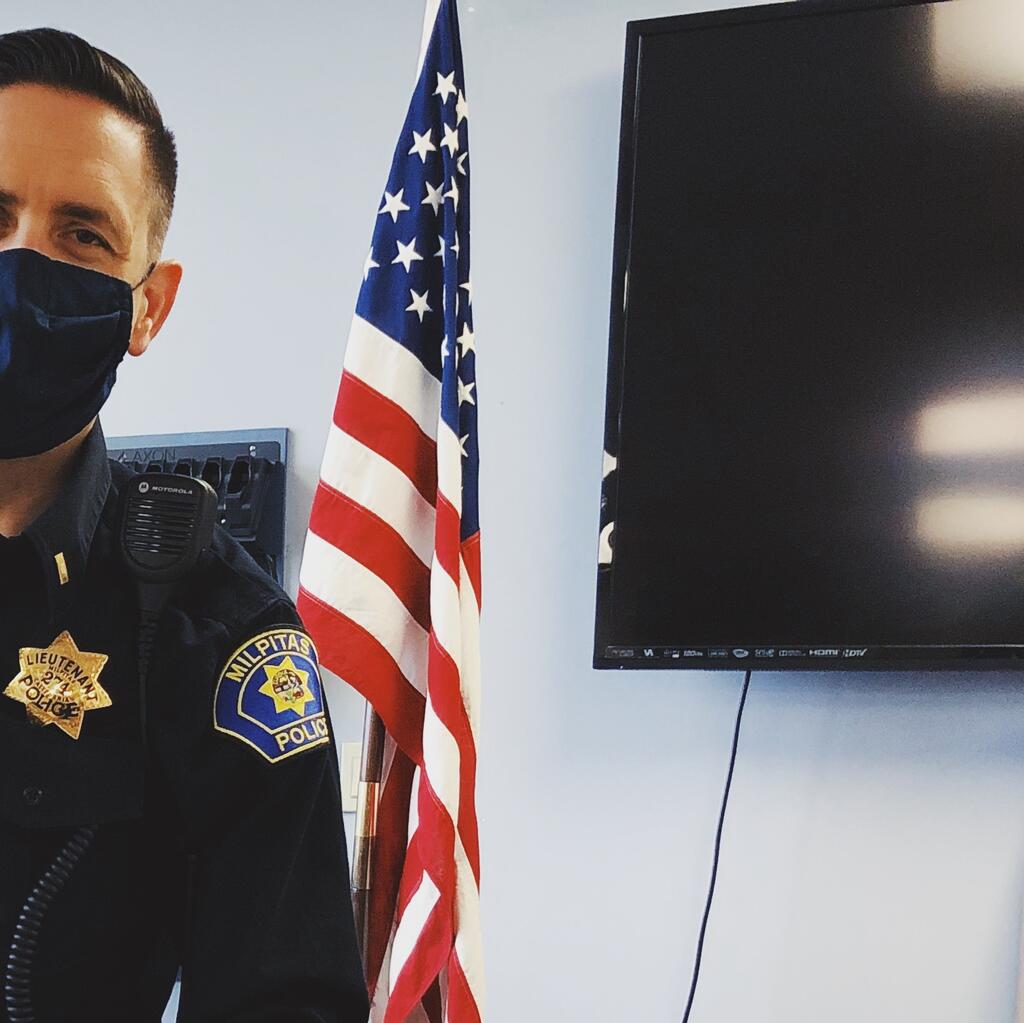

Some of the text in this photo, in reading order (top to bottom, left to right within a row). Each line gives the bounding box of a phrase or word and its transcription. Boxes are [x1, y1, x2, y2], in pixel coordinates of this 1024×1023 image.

[151, 485, 193, 495] MOTOROLA
[26, 652, 98, 701] LIEUTENANT
[225, 633, 311, 683] MILPITAS
[18, 675, 81, 719] POLICE
